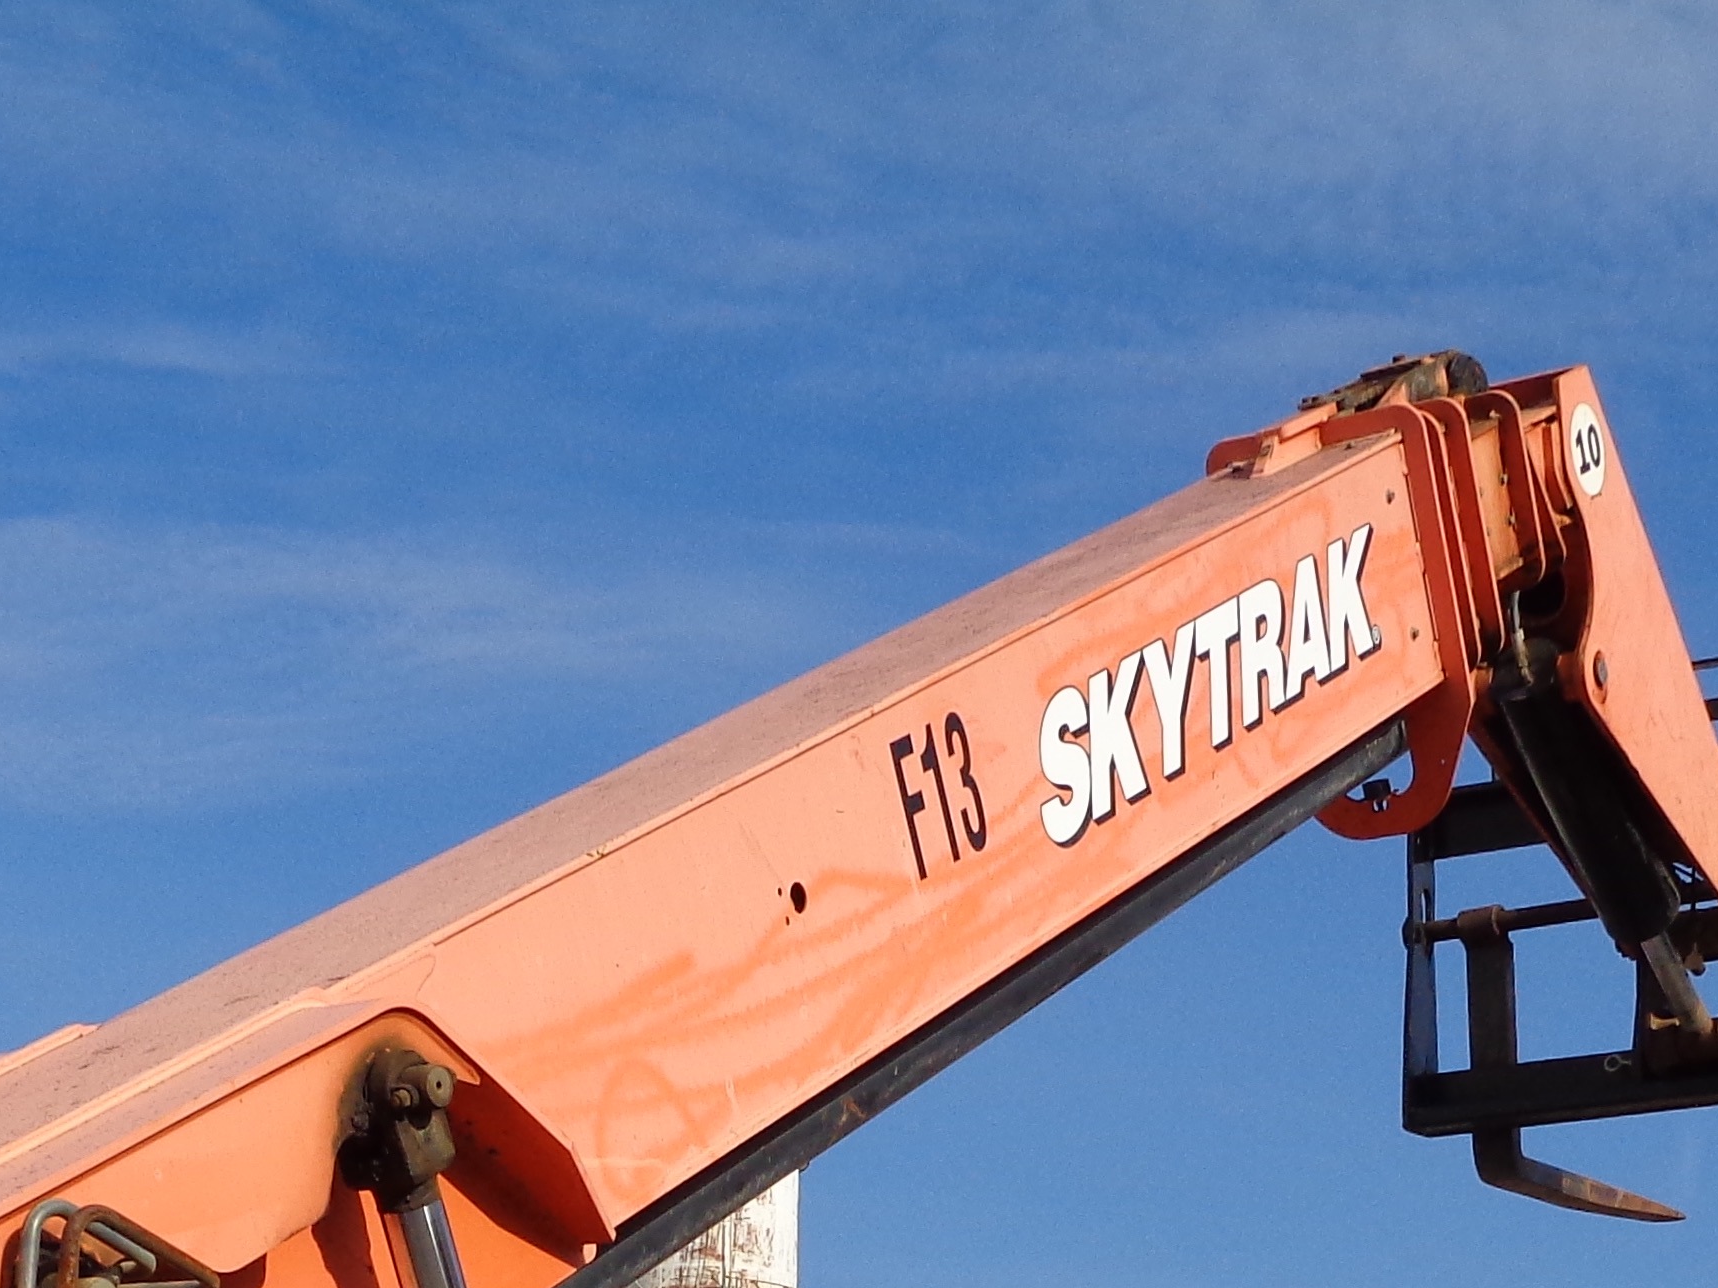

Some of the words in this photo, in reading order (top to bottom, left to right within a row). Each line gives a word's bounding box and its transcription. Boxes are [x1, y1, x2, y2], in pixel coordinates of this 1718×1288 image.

[1575, 423, 1601, 475] 10
[1039, 522, 1375, 848] SKYTRAK
[890, 711, 988, 880] F13
